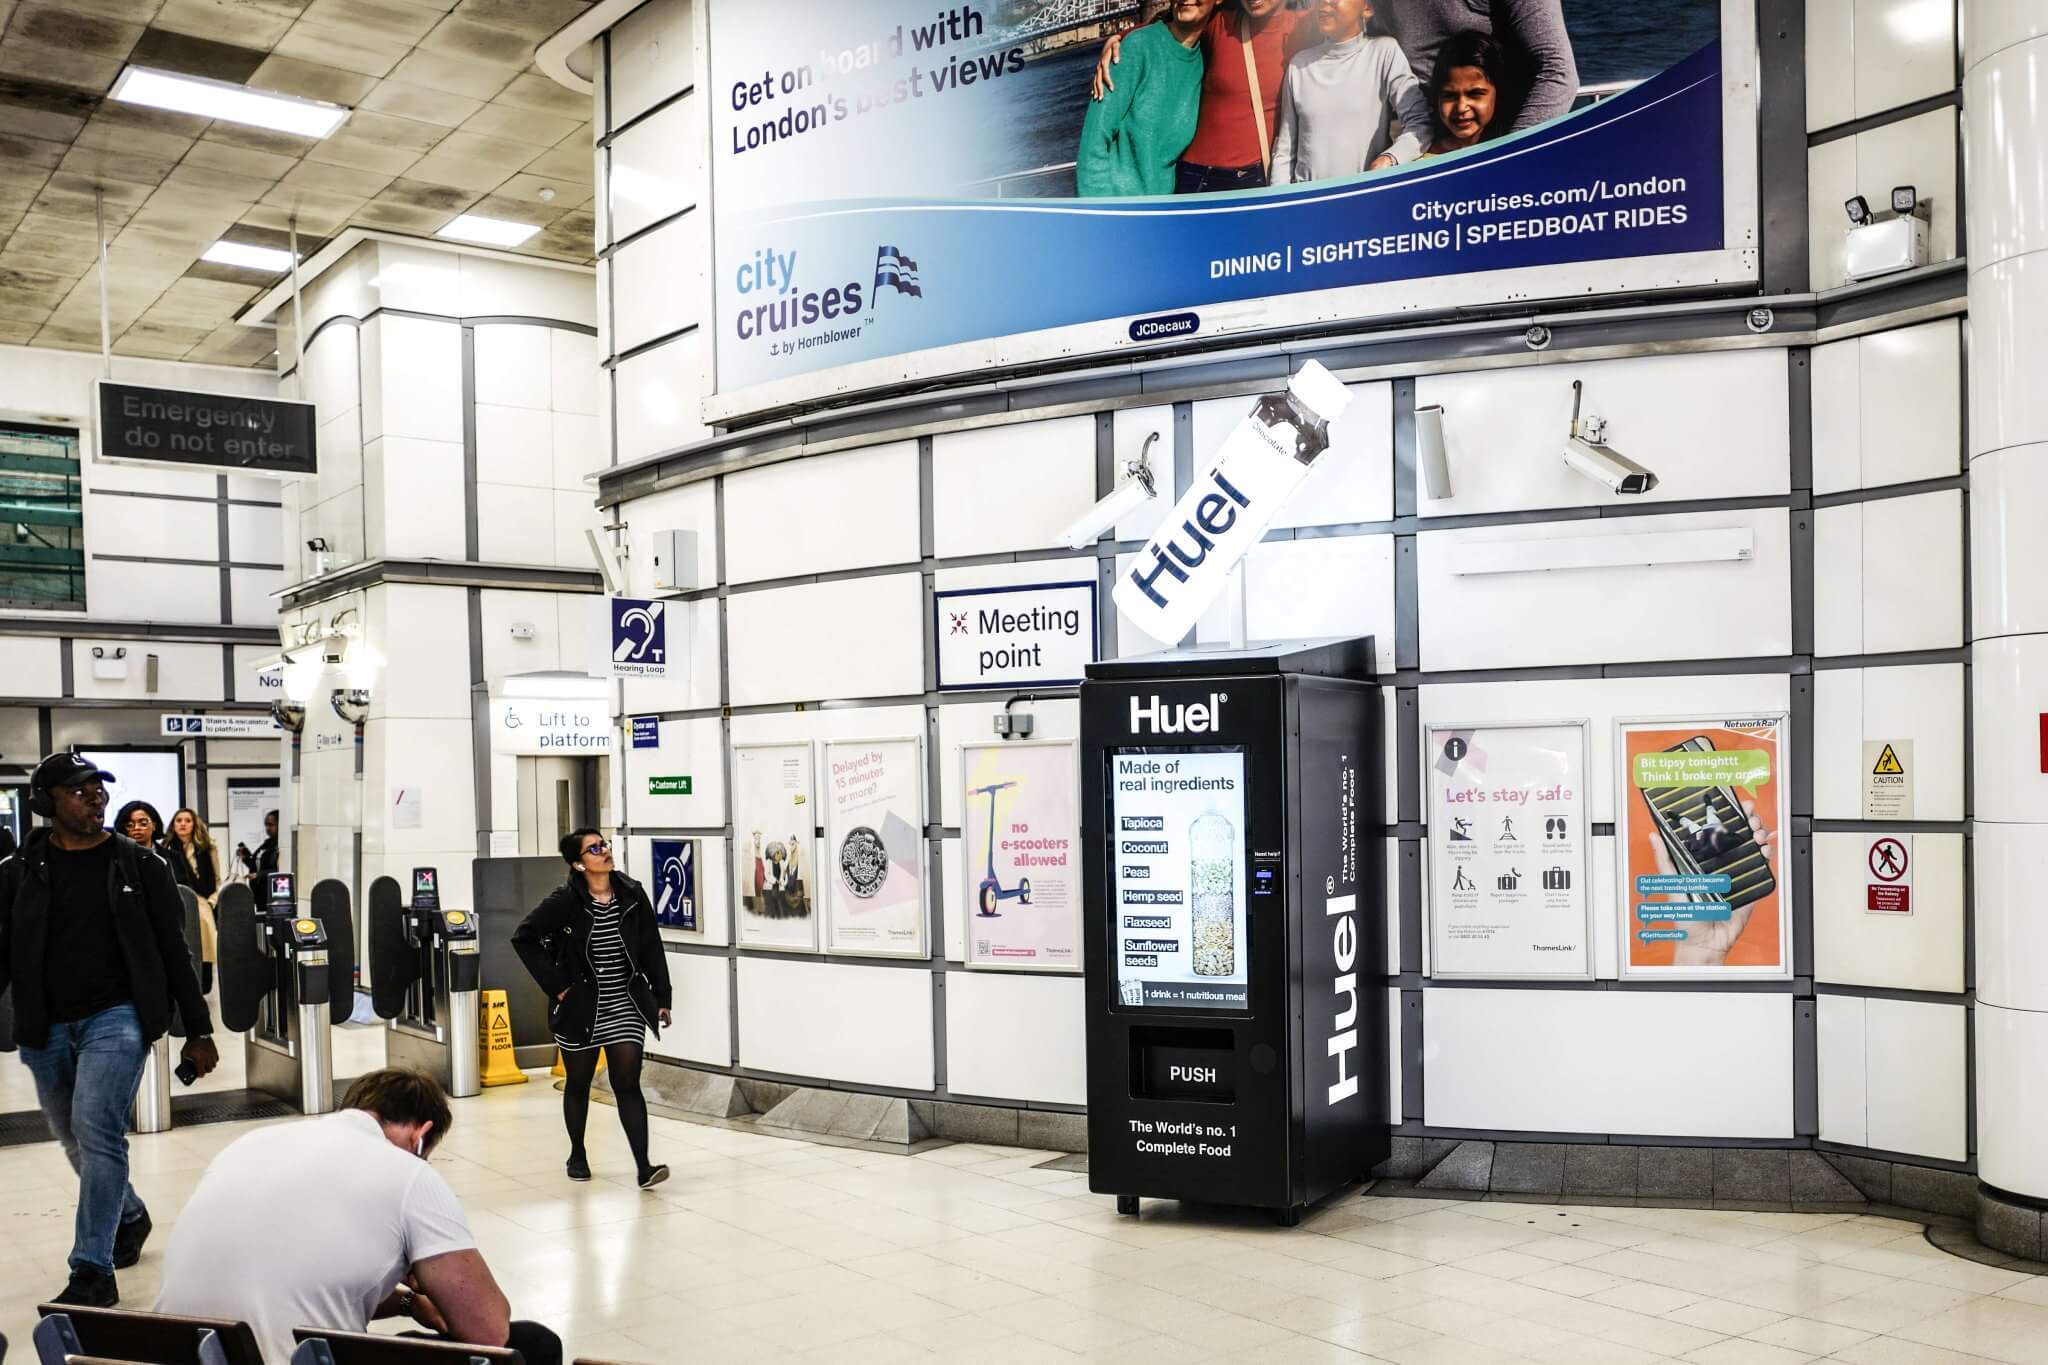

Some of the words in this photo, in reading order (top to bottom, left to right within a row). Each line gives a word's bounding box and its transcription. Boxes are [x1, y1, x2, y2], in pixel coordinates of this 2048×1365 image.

[732, 71, 774, 111] Get
[781, 64, 813, 95] on
[911, 5, 983, 51] with
[732, 93, 848, 155] London's
[930, 47, 1025, 93] views
[1411, 176, 1686, 222] Citycruises.com/London
[1210, 251, 1282, 279] DINING
[1301, 229, 1450, 265] SIGHTSEEING
[1467, 211, 1608, 245] SPEEDBOAT
[1614, 204, 1688, 230] RIDES
[736, 248, 797, 295] city
[737, 282, 863, 340] cruises
[1136, 318, 1192, 337] JCDecaux
[783, 341, 794, 355] by
[798, 326, 862, 350] Hornblower
[123, 395, 276, 433] Emergency
[125, 426, 160, 448] do
[171, 432, 215, 453] not
[224, 437, 296, 459] enter
[1130, 468, 1251, 609] Huel
[979, 606, 1079, 636] Meeting
[980, 643, 1041, 676] point
[614, 664, 644, 674] Hearing
[646, 665, 665, 674] Loop
[539, 712, 566, 727] Lift
[574, 713, 590, 727] to
[539, 733, 610, 748] platform
[832, 755, 869, 775] Delayed
[871, 751, 883, 765] by
[1120, 760, 1161, 775] Made
[1165, 760, 1180, 774] of
[1641, 758, 1656, 768] Bit
[1659, 758, 1685, 769] tipsy
[1688, 756, 1739, 768] tonighttt
[835, 778, 846, 789] 15
[848, 767, 885, 786] minutes
[1642, 772, 1671, 782] Think
[1674, 772, 1679, 781] I
[1682, 770, 1712, 781] broke
[1715, 772, 1733, 782] my
[1873, 776, 1904, 784] CAUTION
[838, 793, 848, 804] or
[849, 782, 877, 801] more?
[1120, 777, 1147, 791] real
[1151, 776, 1234, 794] ingredients
[1446, 787, 1486, 803] Let's
[1492, 788, 1529, 806] stay
[1536, 784, 1573, 801] safe
[1012, 823, 1029, 833] no
[1123, 817, 1162, 830] Tapioca
[1001, 838, 1068, 850] e-scooters
[1123, 843, 1168, 853] Coconut
[1014, 852, 1067, 866] allowed
[1123, 867, 1149, 877] Peas
[1123, 892, 1155, 904] Hemp
[1157, 891, 1183, 902] seed
[1125, 917, 1171, 927] Flaxseed
[1125, 940, 1177, 952] Sunflower
[1126, 955, 1157, 966] seeds
[1144, 990, 1149, 998] 1
[1151, 990, 1171, 998] drink
[1186, 992, 1224, 1000] nutritious
[1226, 993, 1246, 1001] meal
[1170, 1066, 1216, 1083] PUSH
[1128, 1120, 1153, 1133] The
[1156, 1121, 1203, 1135] World's
[1206, 1126, 1226, 1137] no.
[1230, 1126, 1236, 1137] 1
[1136, 1140, 1196, 1156] Complete
[1199, 1143, 1231, 1157] Food
